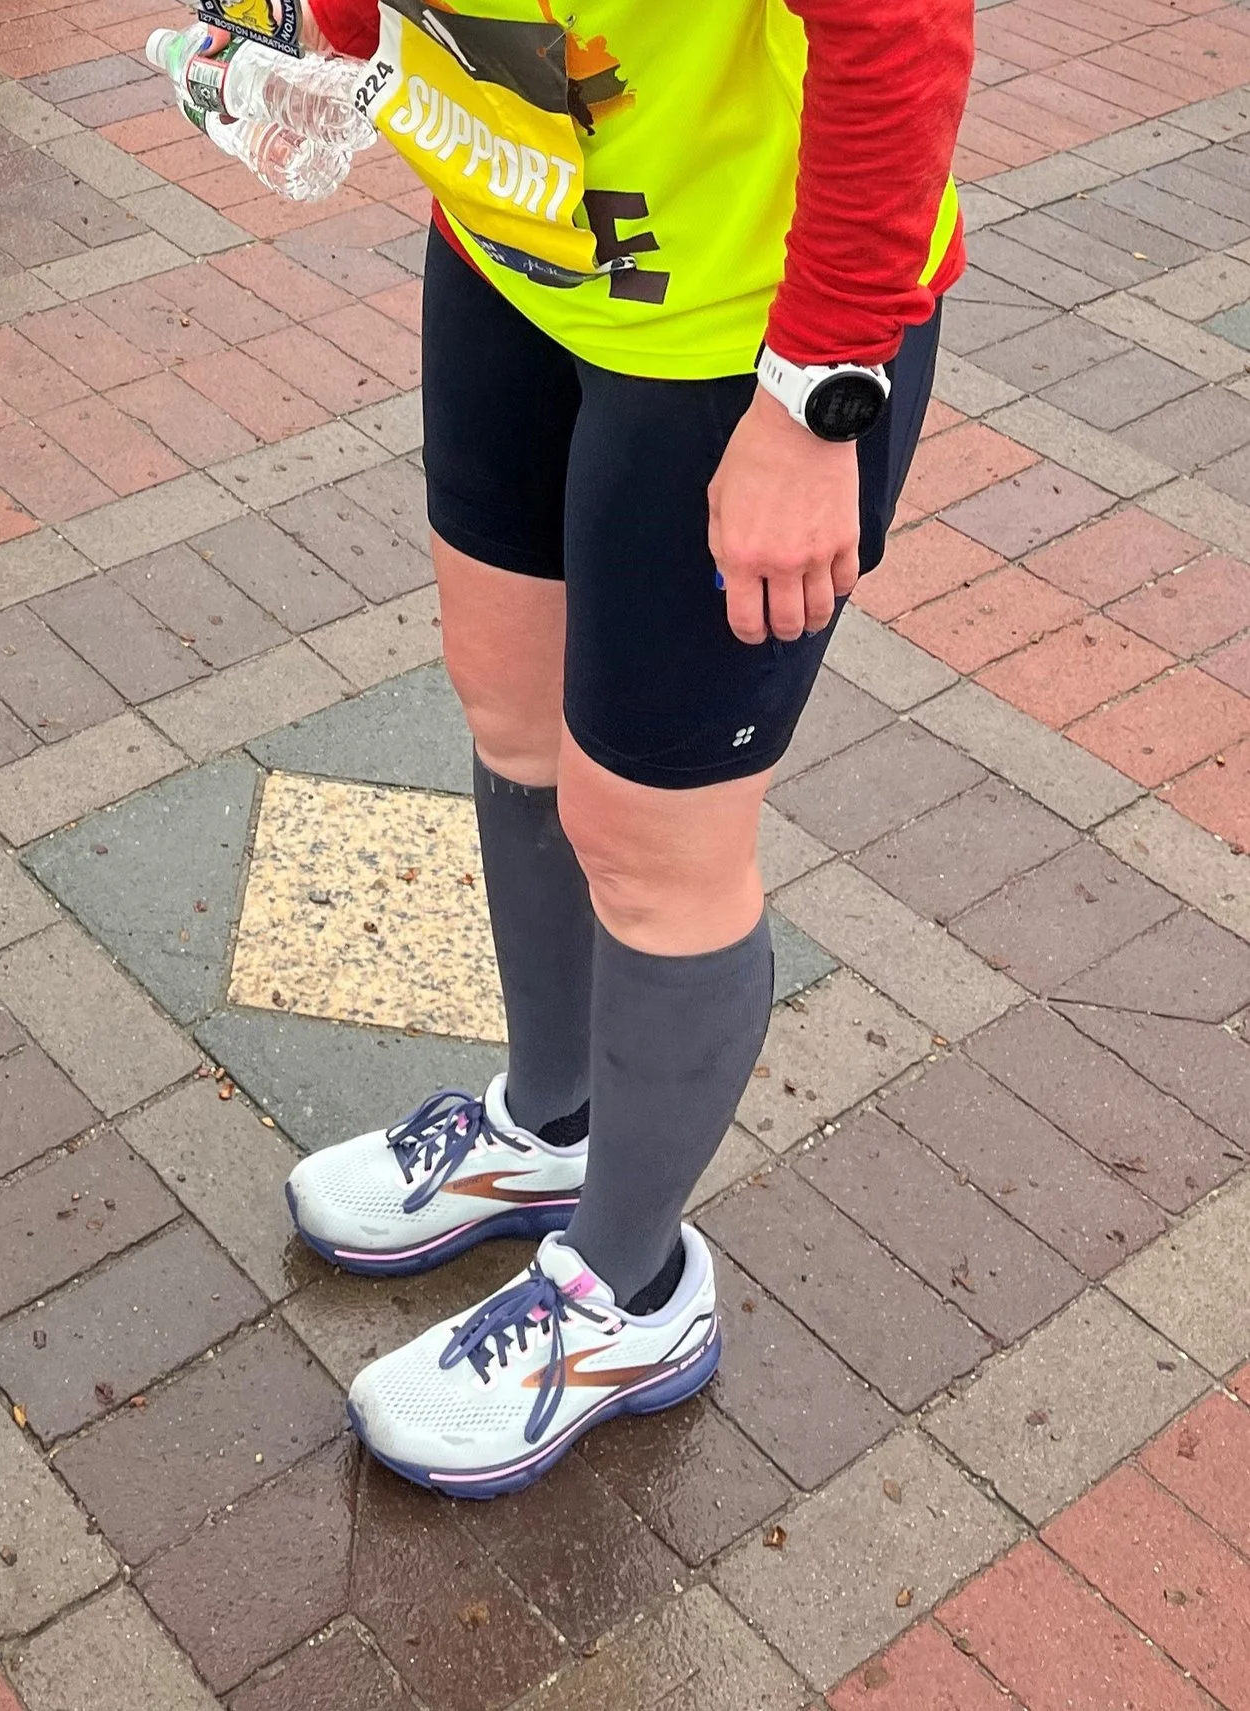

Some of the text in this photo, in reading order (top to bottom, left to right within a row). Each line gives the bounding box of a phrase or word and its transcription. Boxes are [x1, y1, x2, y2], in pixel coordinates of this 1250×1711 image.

[215, 17, 249, 37] BOSTON
[250, 32, 298, 57] MARATHON
[389, 74, 577, 222] SUPPORT
